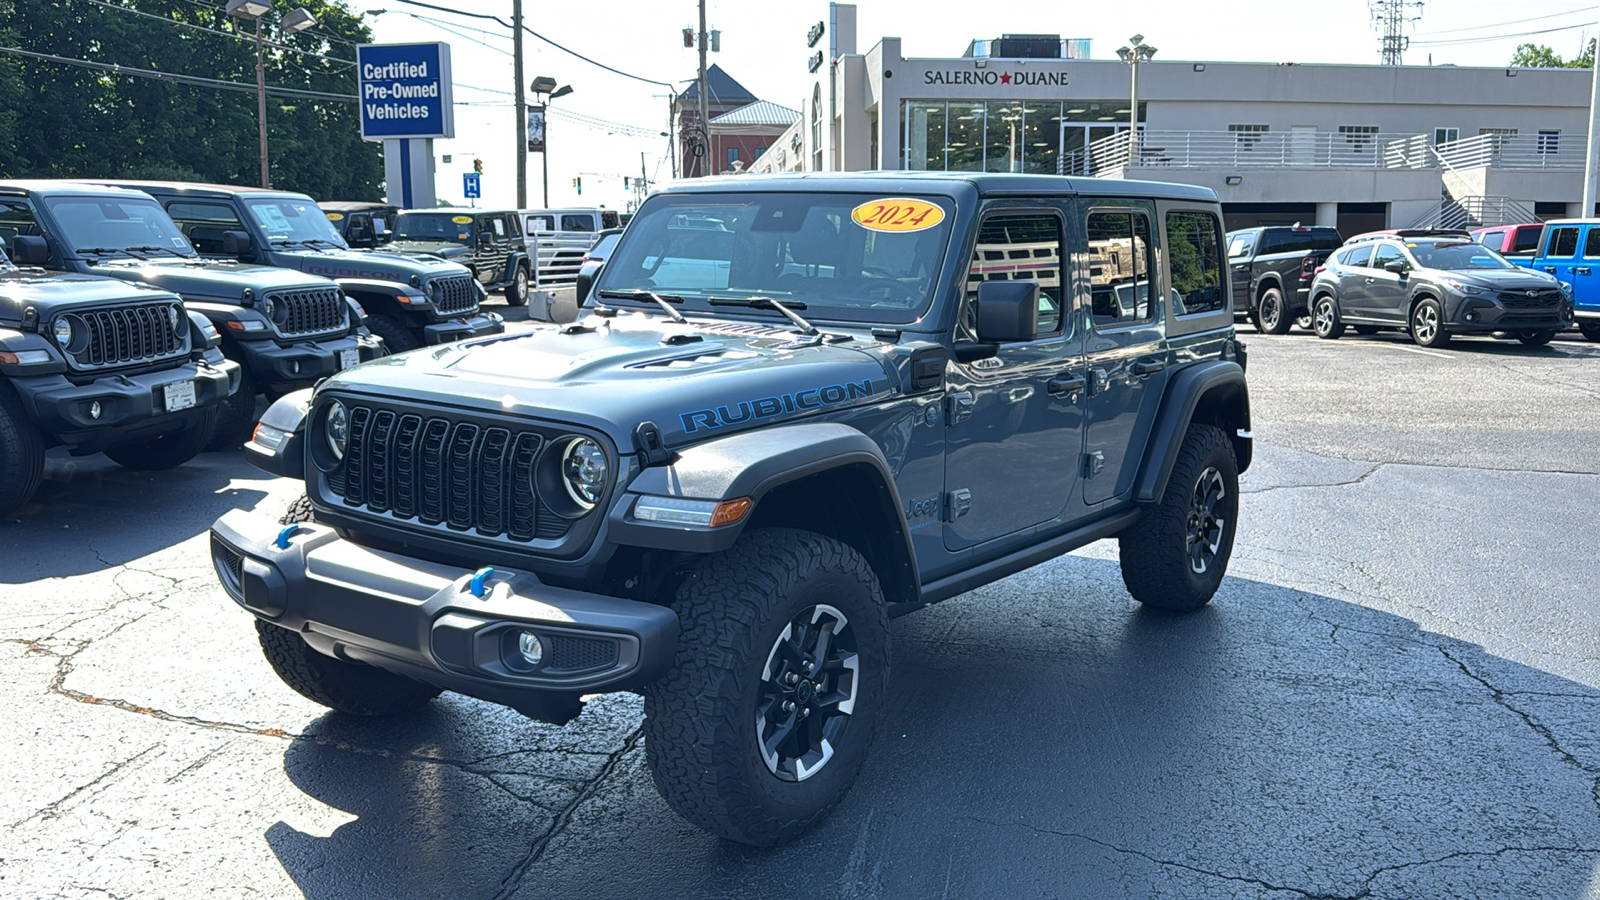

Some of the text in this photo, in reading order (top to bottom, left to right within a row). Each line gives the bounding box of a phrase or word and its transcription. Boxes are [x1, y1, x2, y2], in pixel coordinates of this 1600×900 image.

[364, 61, 428, 80] Certified
[924, 70, 1069, 86] SALERNO DUANE
[365, 81, 438, 99] Pre-Owned
[366, 103, 429, 120] Vehicles
[466, 178, 478, 192] H
[861, 205, 935, 226] 2024
[308, 266, 401, 280] RUBICON
[678, 378, 875, 434] RUBICON
[905, 497, 938, 519] Jeep
